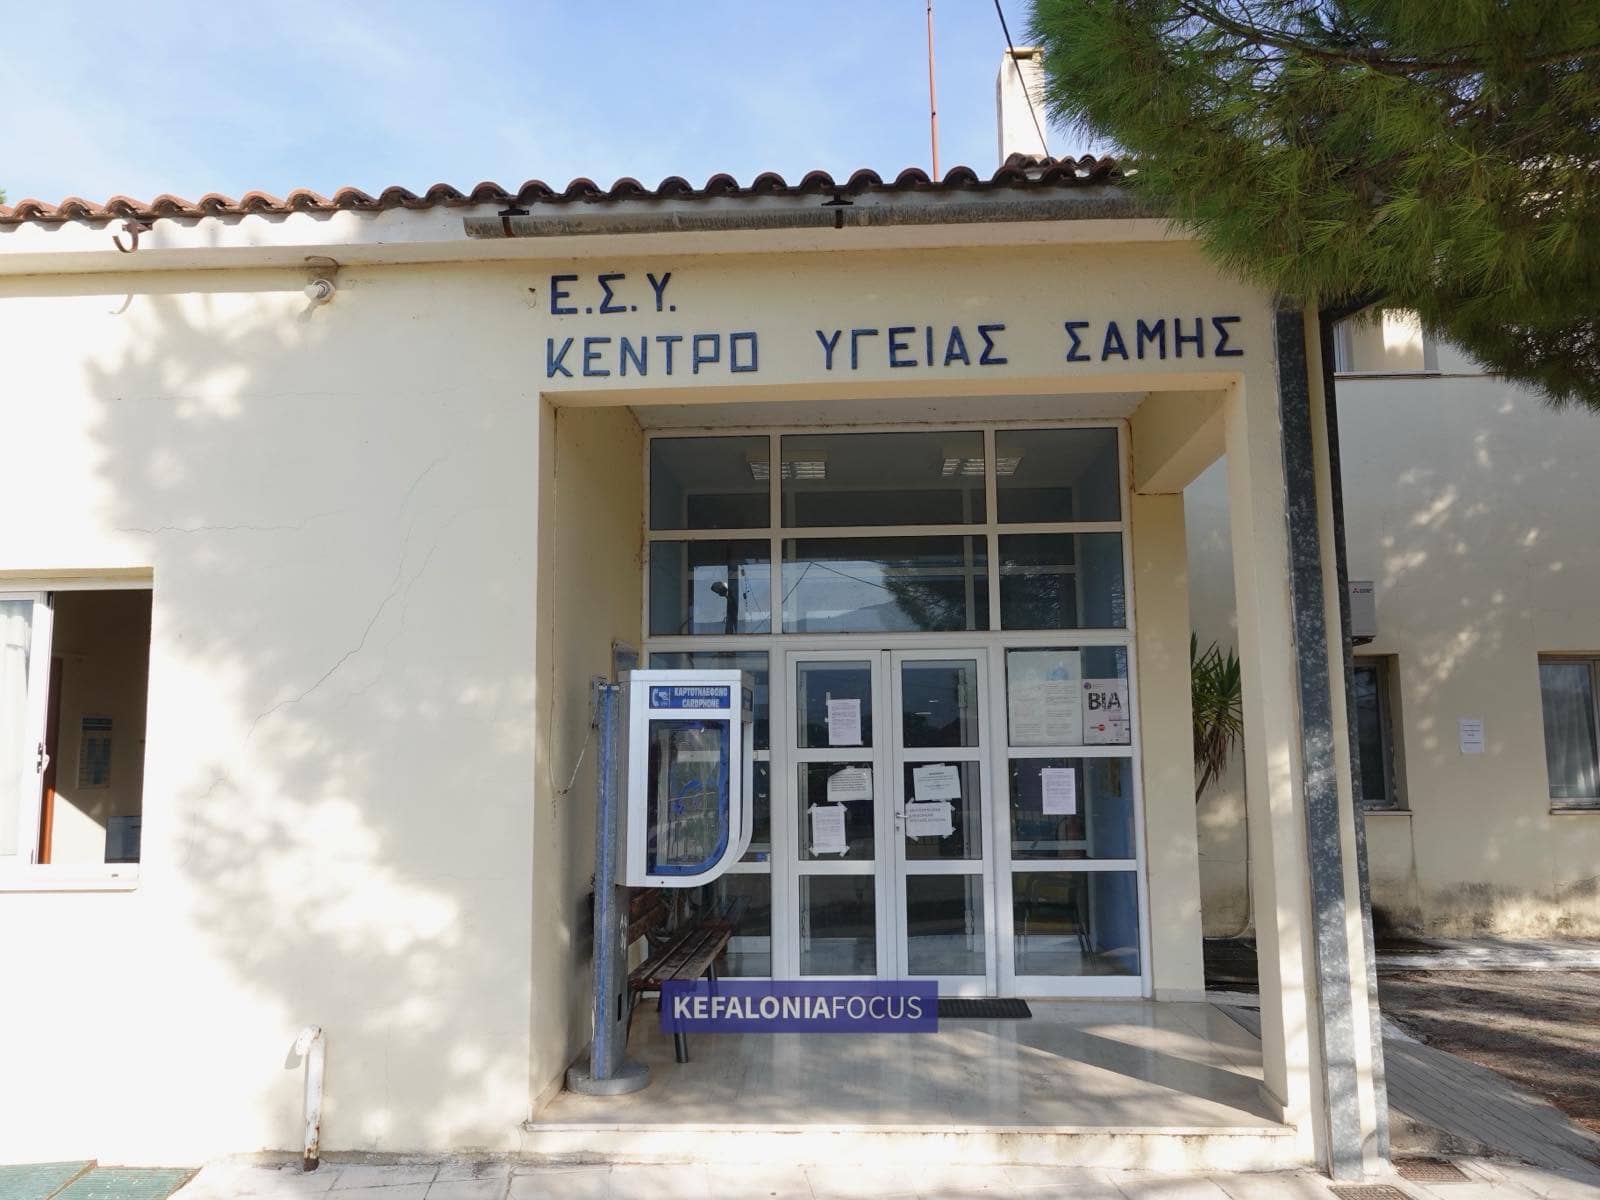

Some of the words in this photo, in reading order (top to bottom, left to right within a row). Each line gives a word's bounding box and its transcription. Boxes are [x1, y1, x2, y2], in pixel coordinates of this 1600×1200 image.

[551, 272, 677, 315] Ε.Σ.Υ.
[547, 332, 758, 378] ΚΕΝΤΡΟ
[816, 324, 1008, 370] ΥΓΕΙΑΣ
[1065, 315, 1244, 361] ΣΑΜΗΣ
[682, 698, 721, 708] CARDPHONE
